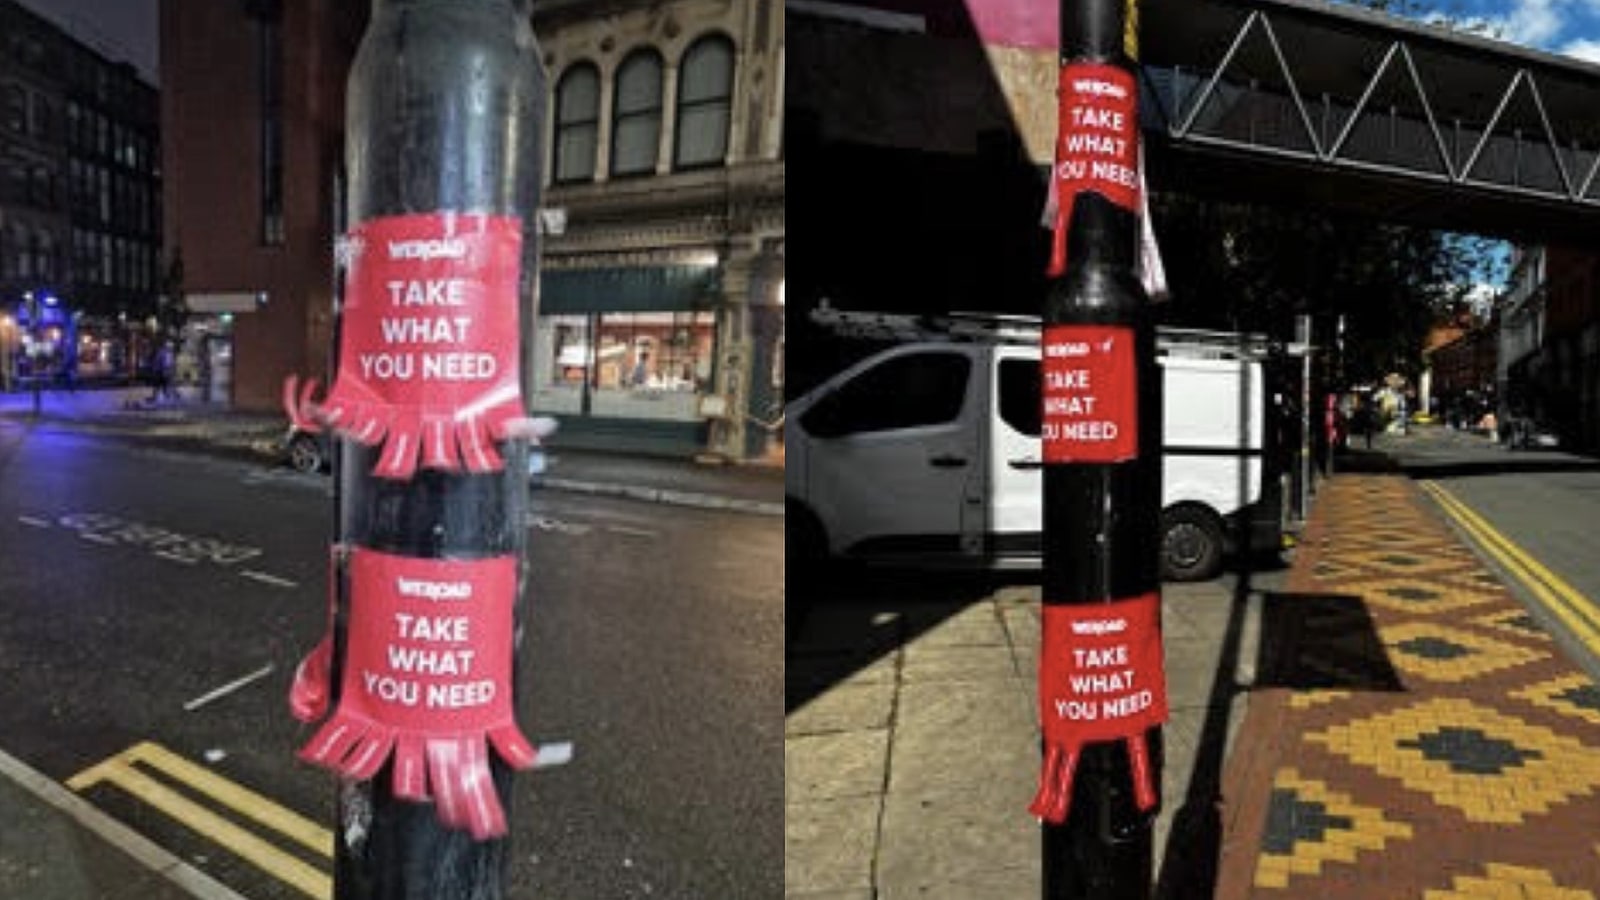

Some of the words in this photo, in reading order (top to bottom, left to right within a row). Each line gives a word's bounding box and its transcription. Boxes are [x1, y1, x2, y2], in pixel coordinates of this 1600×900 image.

[1071, 107, 1124, 131] TAKE
[1067, 135, 1126, 157] WHAT
[1059, 160, 1086, 180] OU
[387, 280, 466, 307] TAKE
[381, 318, 472, 343] WHAT
[361, 354, 414, 380] YOU
[422, 354, 496, 380] NEED
[1062, 422, 1118, 440] NEED
[396, 613, 469, 641] TAKE
[388, 645, 475, 675] WHAT
[1072, 645, 1128, 669] TAKE
[363, 669, 419, 706] YOU
[426, 681, 496, 708] NEED
[1069, 669, 1134, 694] WHAT
[1055, 699, 1098, 720] YOU
[1103, 689, 1152, 719] NEED
